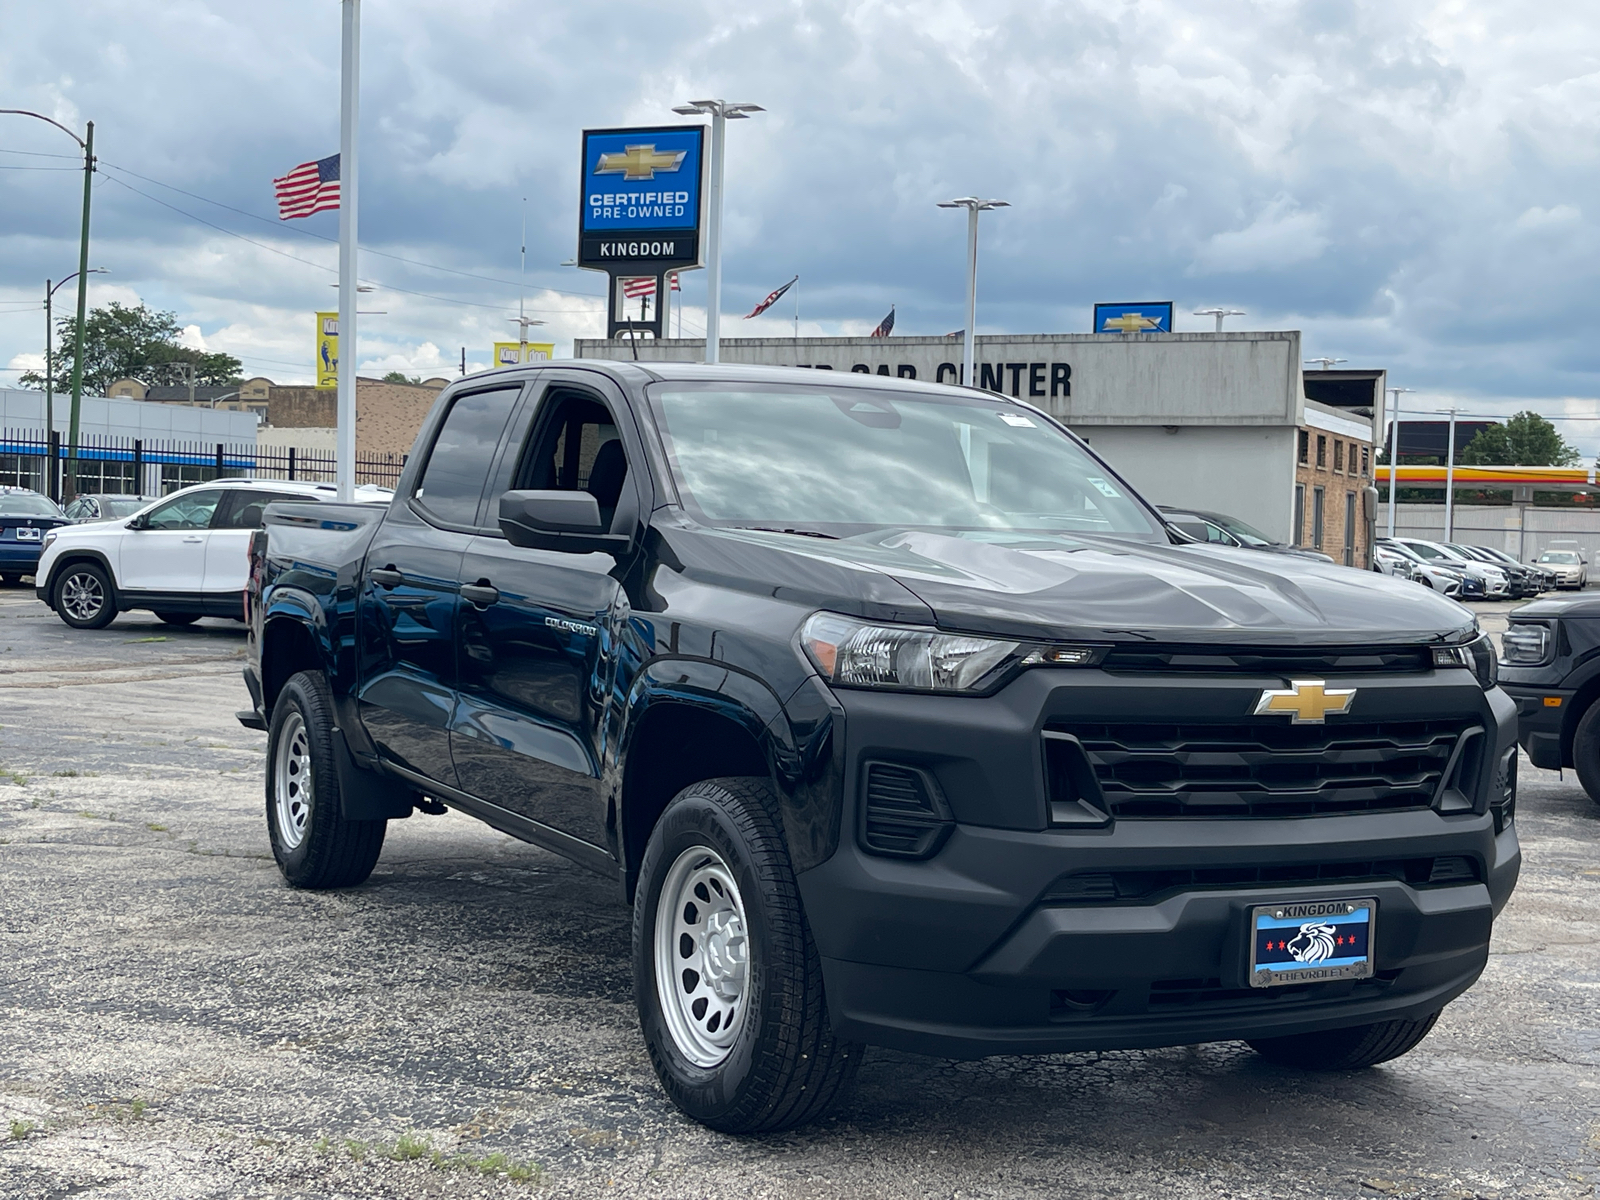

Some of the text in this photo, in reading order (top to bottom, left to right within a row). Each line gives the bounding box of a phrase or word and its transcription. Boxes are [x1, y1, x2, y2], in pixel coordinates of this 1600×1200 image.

[589, 191, 689, 206] CERTIFIED
[593, 205, 684, 219] PRE-OWNED
[600, 242, 675, 256] KINGDOM
[322, 317, 340, 334] Kin
[545, 616, 597, 636] COLORADO
[1283, 902, 1347, 918] KINGDOM
[1279, 968, 1343, 982] CHEVROLET
